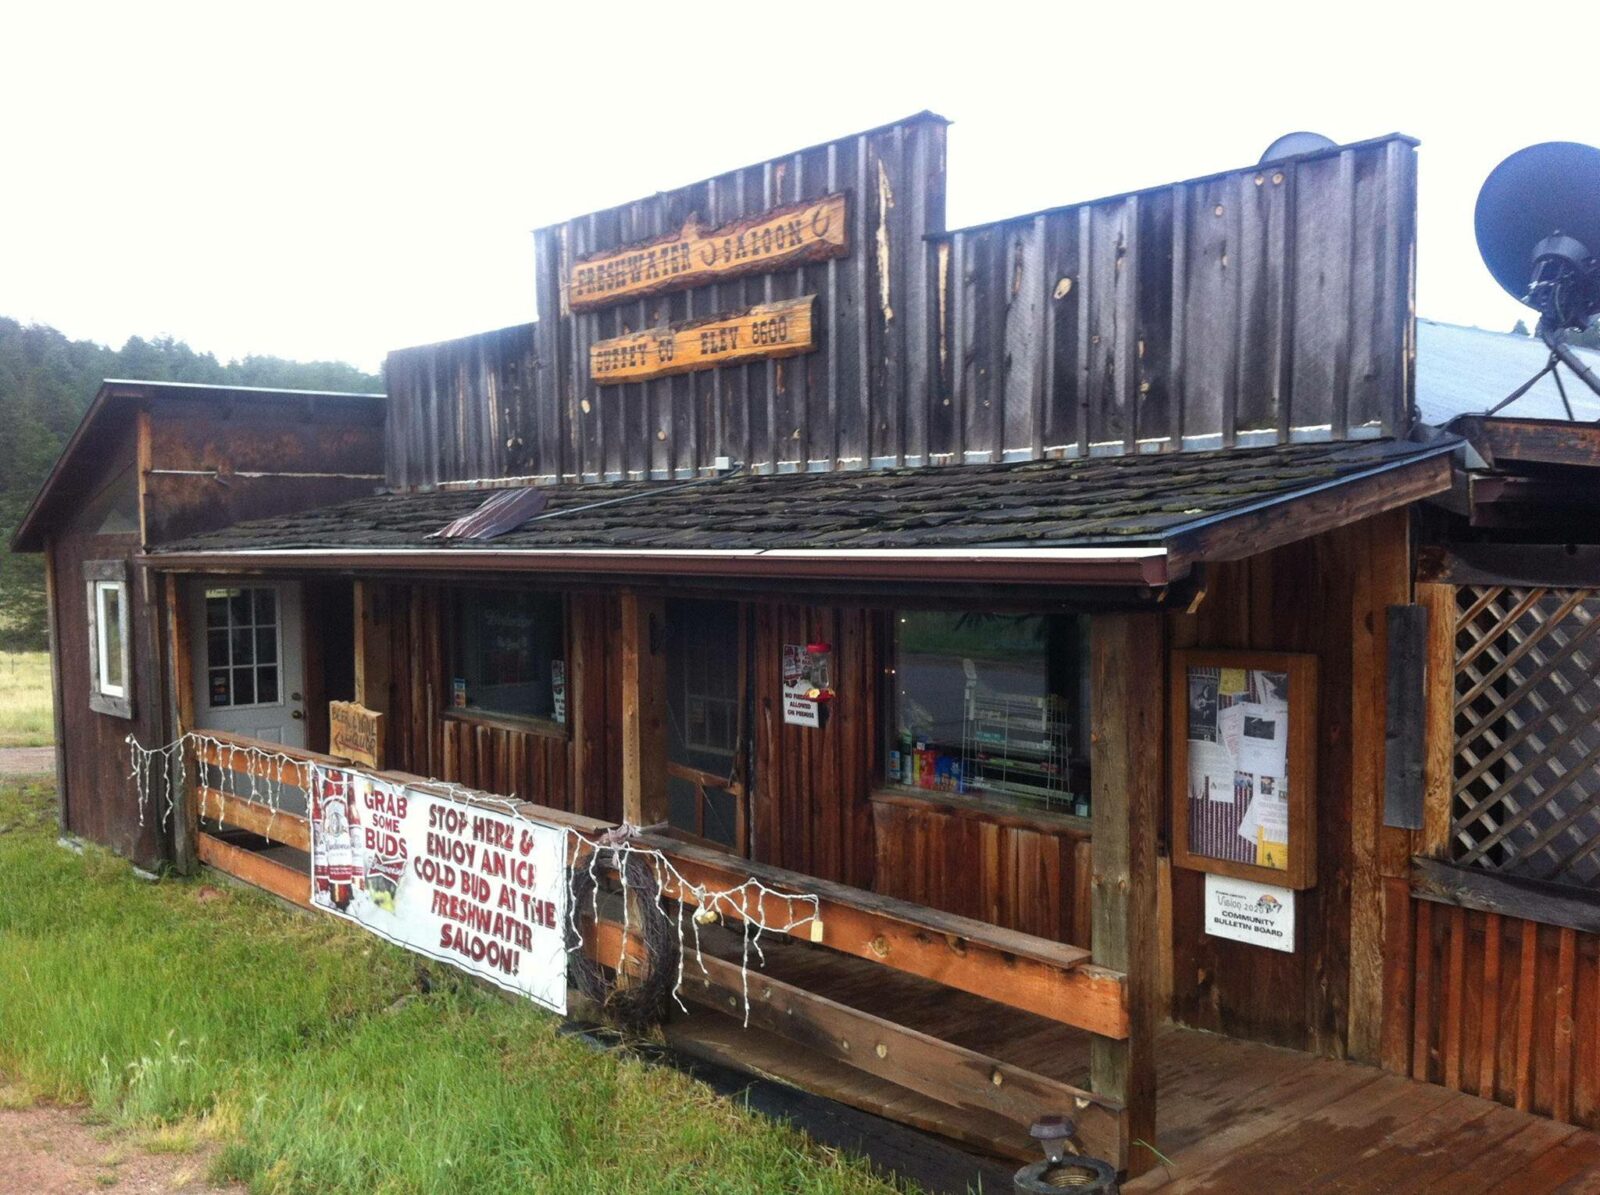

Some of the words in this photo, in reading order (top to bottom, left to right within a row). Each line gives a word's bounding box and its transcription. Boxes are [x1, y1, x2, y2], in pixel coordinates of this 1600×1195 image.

[723, 220, 803, 263] SALOON
[659, 338, 673, 362] CO
[701, 326, 738, 355] ELEV
[752, 315, 787, 345] 8600
[364, 790, 408, 820] GRAB
[372, 813, 401, 834] SOME
[365, 827, 408, 860] BUDS
[429, 803, 467, 837] STOP
[519, 829, 534, 857] &
[427, 831, 476, 868] ENJOY
[481, 849, 506, 879] AN
[413, 856, 456, 889] COLD
[460, 869, 491, 904] BUD
[498, 884, 517, 914] AT
[521, 893, 556, 930] THE
[431, 889, 532, 953] FRESHWATER
[1214, 917, 1252, 931] BULLETIN
[1254, 925, 1284, 937] BOARD
[1222, 910, 1275, 927] COMMUNITY
[440, 923, 520, 977] SALOON!
